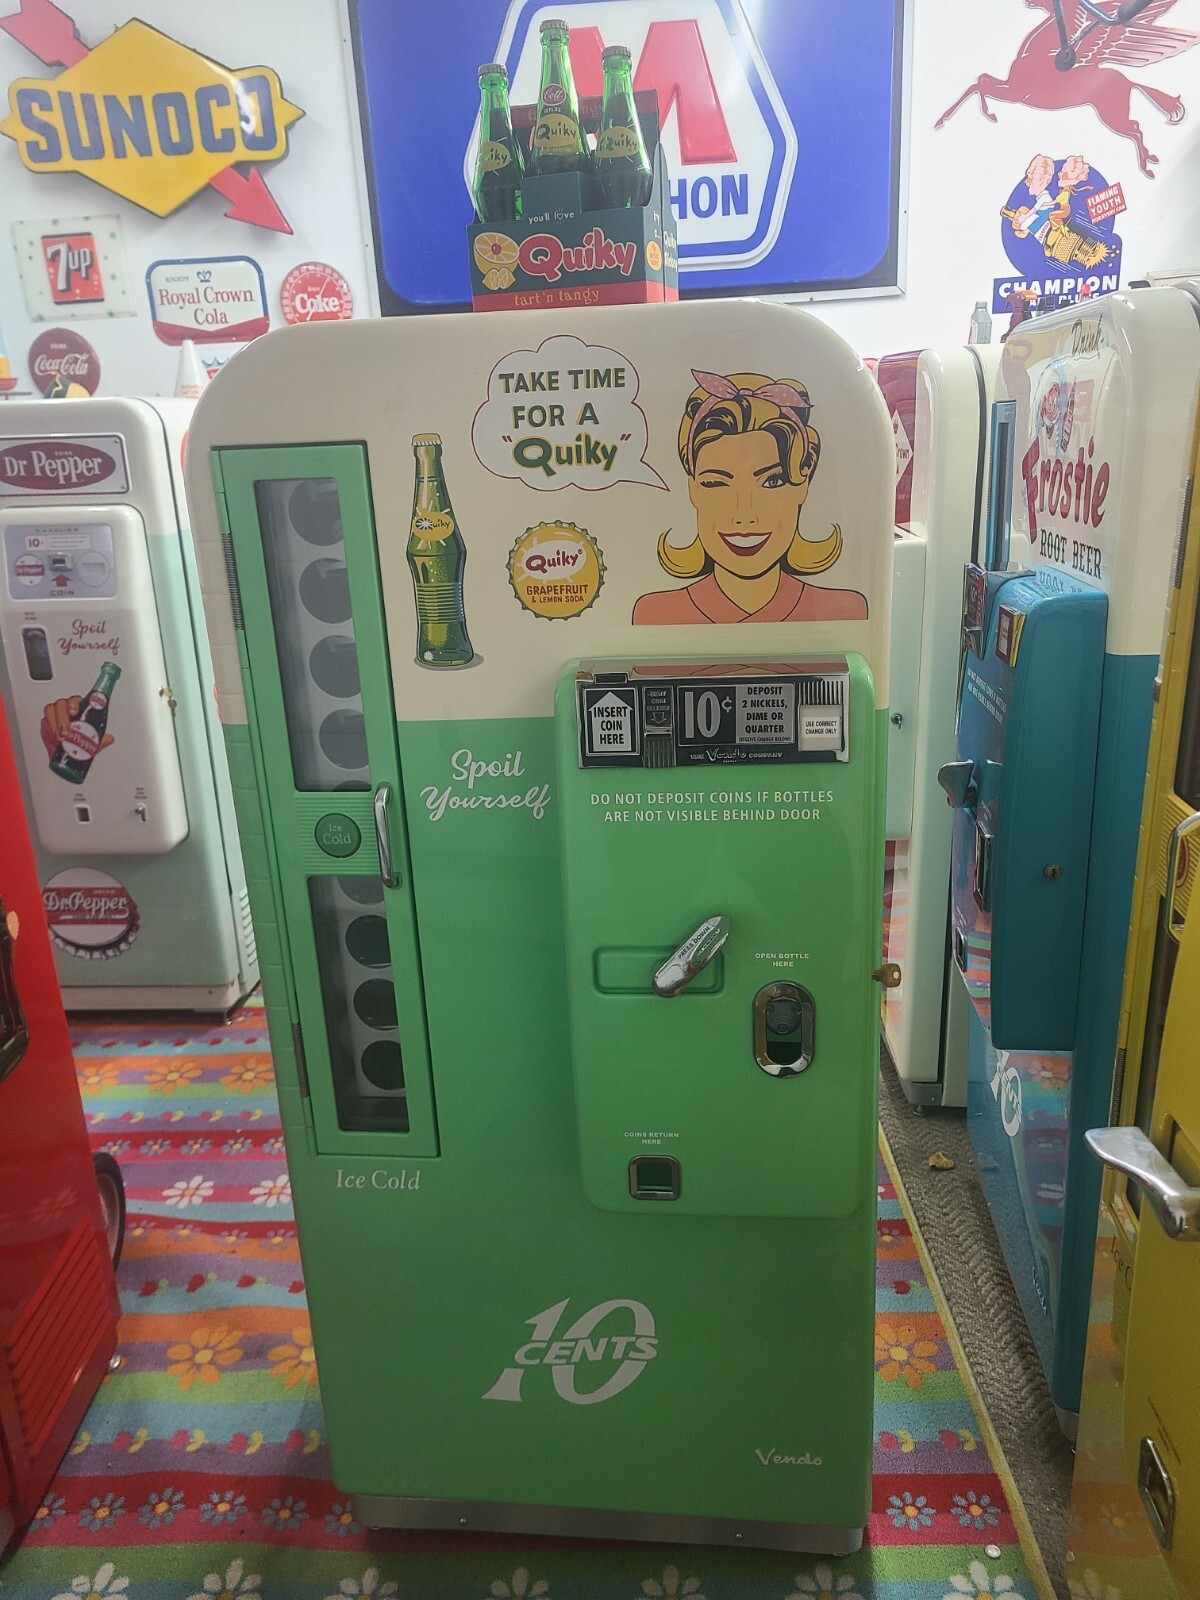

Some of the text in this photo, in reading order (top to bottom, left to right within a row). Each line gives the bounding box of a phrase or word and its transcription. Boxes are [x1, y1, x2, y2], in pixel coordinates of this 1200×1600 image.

[16, 74, 277, 163] SUNOCO
[536, 122, 577, 141] Quiky
[1087, 186, 1119, 206] FLAMING
[1090, 197, 1122, 216] YOUTH
[528, 212, 550, 225] you'll
[518, 227, 637, 282] Quiky
[998, 275, 1118, 298] CHAMPION
[158, 284, 254, 310] Royal Crown
[295, 293, 340, 314] Coke
[514, 292, 541, 306] tart
[558, 287, 600, 304] tangy
[193, 307, 229, 326] Cola
[499, 368, 626, 393] TAKE TIME
[512, 402, 600, 429] FOR A
[3, 450, 102, 484] Dr Pepper
[1022, 436, 1110, 545] Frostie
[525, 549, 579, 573] Quiky
[1040, 528, 1102, 580] ROOT BEER
[526, 584, 589, 596] GRAPEFRUIT
[565, 595, 584, 603] SODA
[71, 618, 107, 639] Spoil
[57, 638, 121, 656] Yourself
[747, 686, 783, 695] DEPOSIT
[593, 707, 628, 717] INSERT
[742, 699, 788, 709] 2 NICKELS,
[600, 720, 623, 731] COIN
[746, 712, 784, 721] DIME OR
[599, 733, 625, 745] HERE
[745, 725, 784, 734] QUARTER
[451, 749, 525, 789] Spoil
[420, 784, 551, 821] Yourself
[591, 790, 834, 805] DO NOT DEPOSIT COINS IF BOTTLES
[604, 808, 821, 822] ARE NOT VISIBLE BEHIND DOOR
[328, 824, 343, 832] Ice
[322, 833, 352, 845] Cold
[677, 926, 710, 960] PRESS DOWN
[336, 1169, 422, 1190] Ice Cold
[481, 1297, 655, 1405] 10
[514, 1335, 659, 1366] CENTS
[755, 1448, 823, 1466] Vendo
